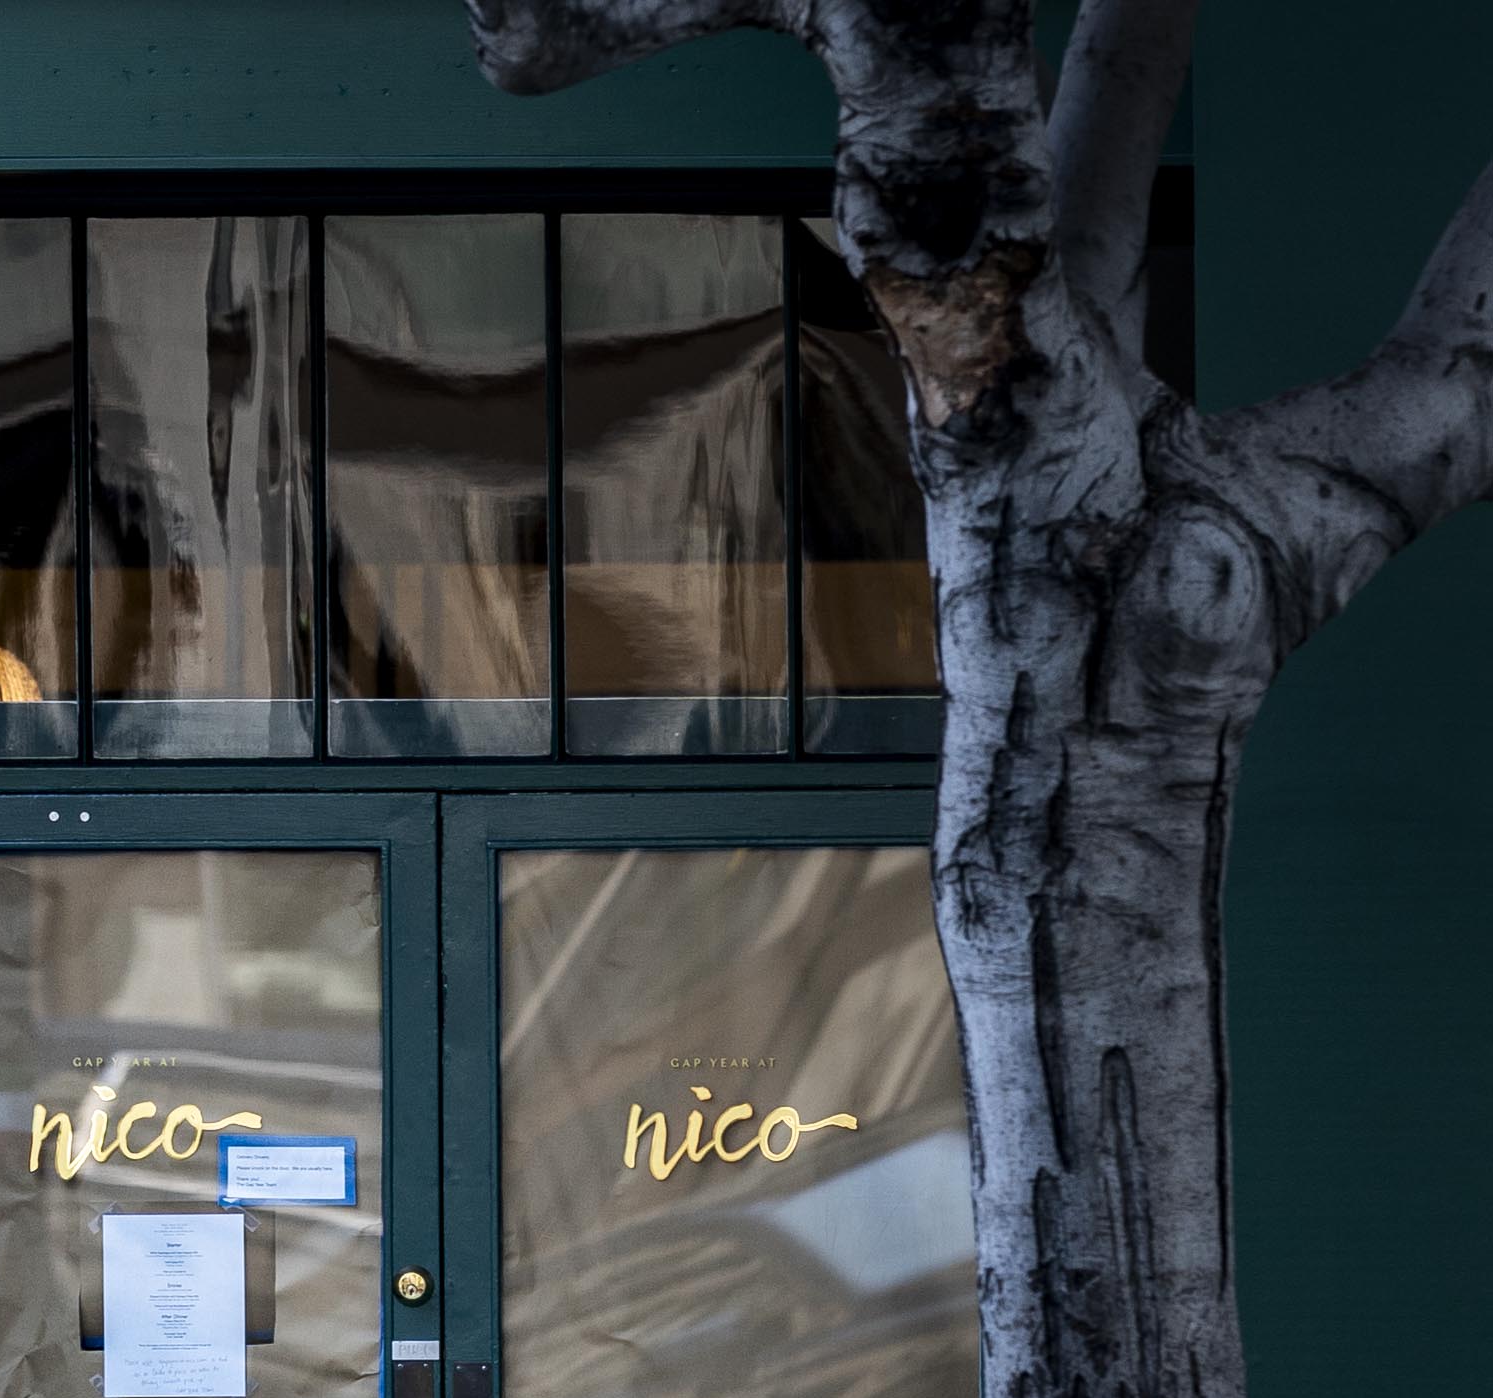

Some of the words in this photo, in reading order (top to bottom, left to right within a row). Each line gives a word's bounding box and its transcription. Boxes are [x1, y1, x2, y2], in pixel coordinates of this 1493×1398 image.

[72, 1057, 104, 1067] GAP
[112, 1057, 151, 1067] YAR
[159, 1057, 177, 1067] AT
[670, 1057, 702, 1068] GAP
[710, 1057, 750, 1068] YEAR
[758, 1057, 776, 1068] AT
[29, 1085, 263, 1181] nico
[623, 1085, 858, 1181] nico
